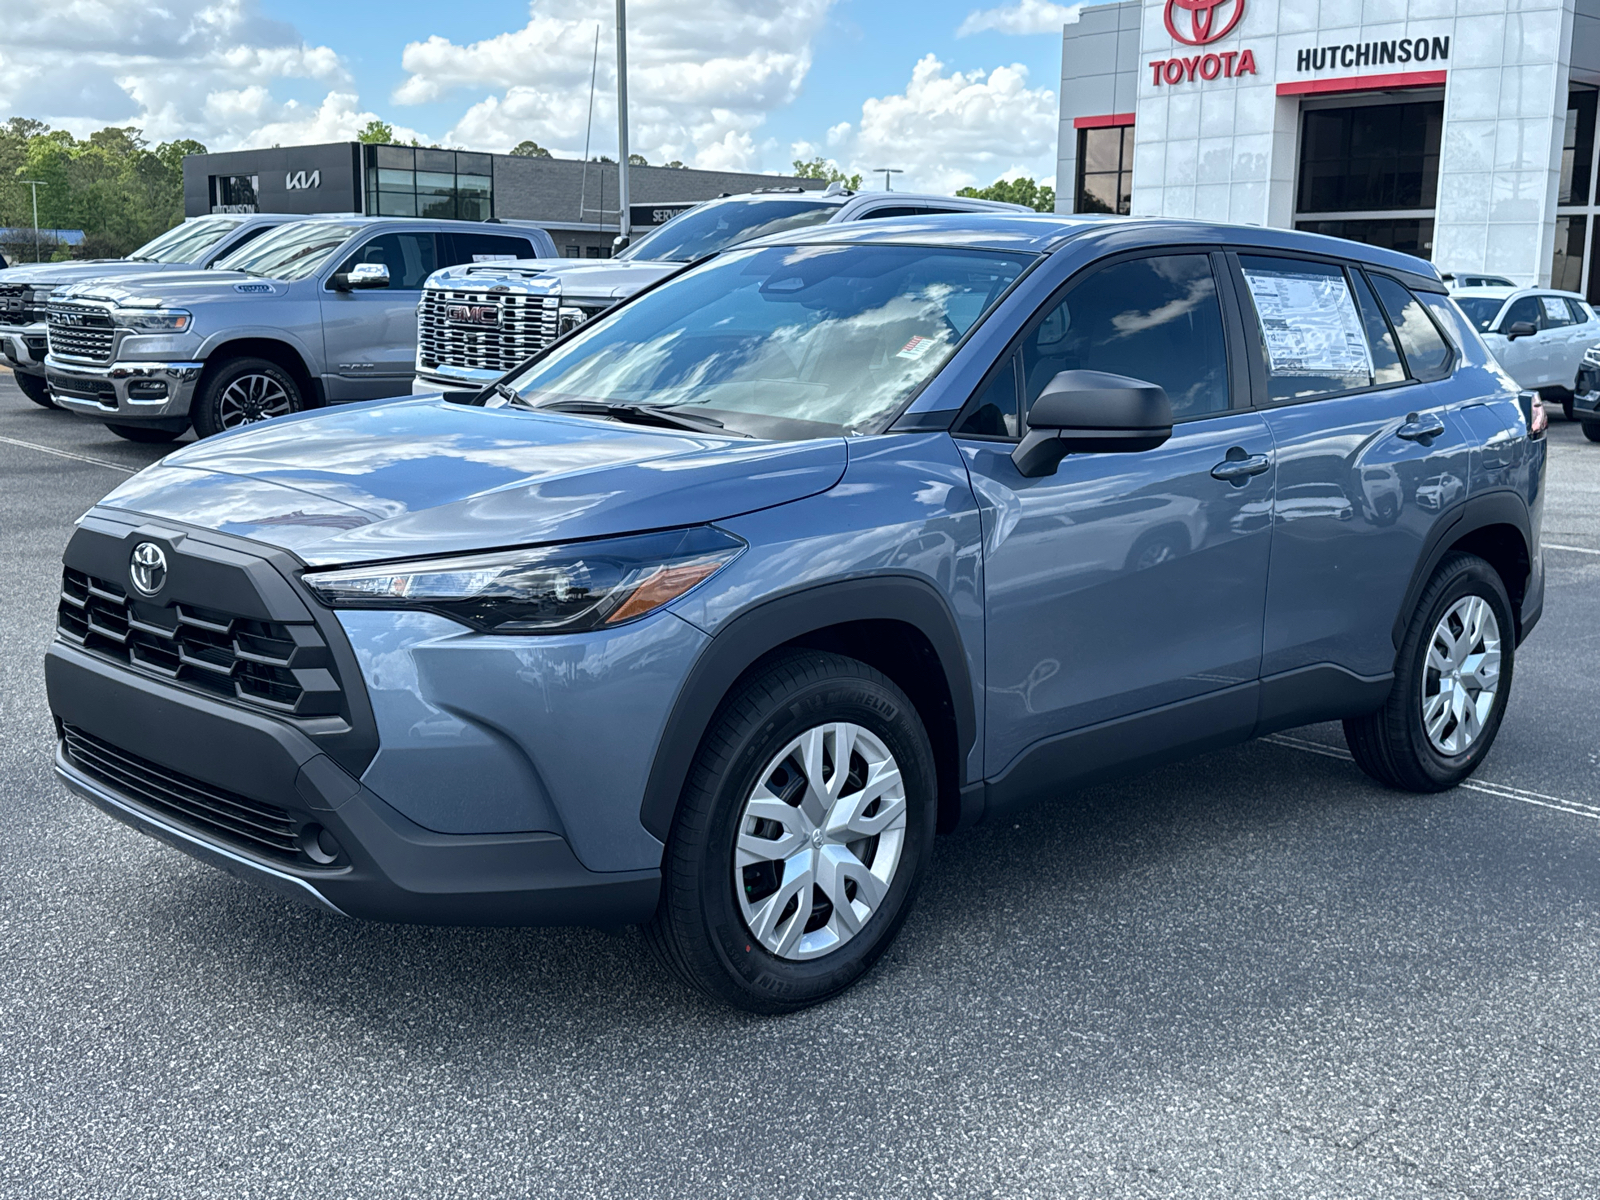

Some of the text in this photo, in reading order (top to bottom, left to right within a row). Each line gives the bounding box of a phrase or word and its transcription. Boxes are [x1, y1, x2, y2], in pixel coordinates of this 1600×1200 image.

[1149, 49, 1257, 86] TOYOTA
[1296, 36, 1450, 72] HUTCHINSON
[285, 170, 320, 190] KIA
[447, 305, 498, 324] GMC
[827, 691, 895, 718] MICHELIN
